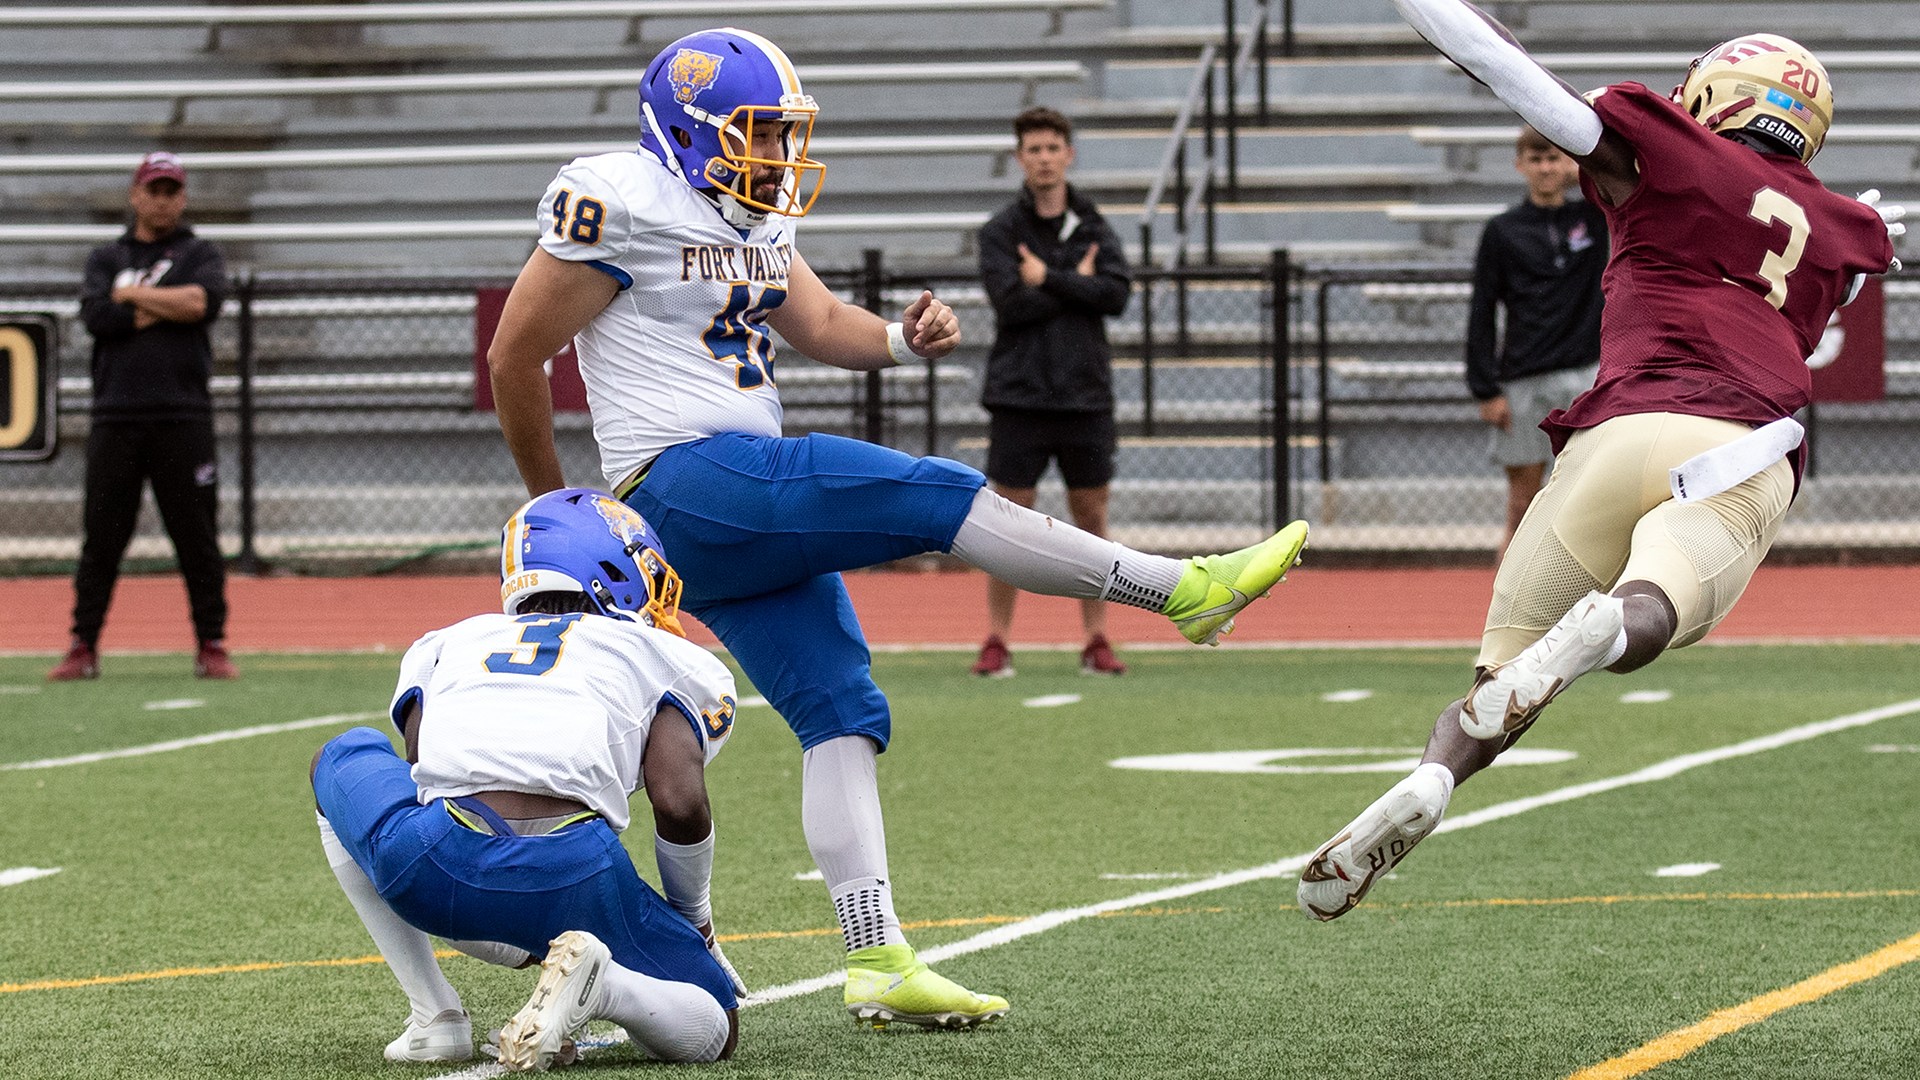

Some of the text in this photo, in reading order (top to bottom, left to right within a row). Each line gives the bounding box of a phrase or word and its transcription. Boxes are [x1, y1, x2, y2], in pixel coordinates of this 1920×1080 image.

[1781, 59, 1820, 99] 20
[1756, 117, 1805, 149] schutt
[553, 187, 607, 247] 48
[681, 244, 738, 281] FORT
[1747, 184, 1812, 311] 3
[523, 542, 532, 554] 3
[481, 612, 588, 677] 3
[701, 693, 736, 741] 3
